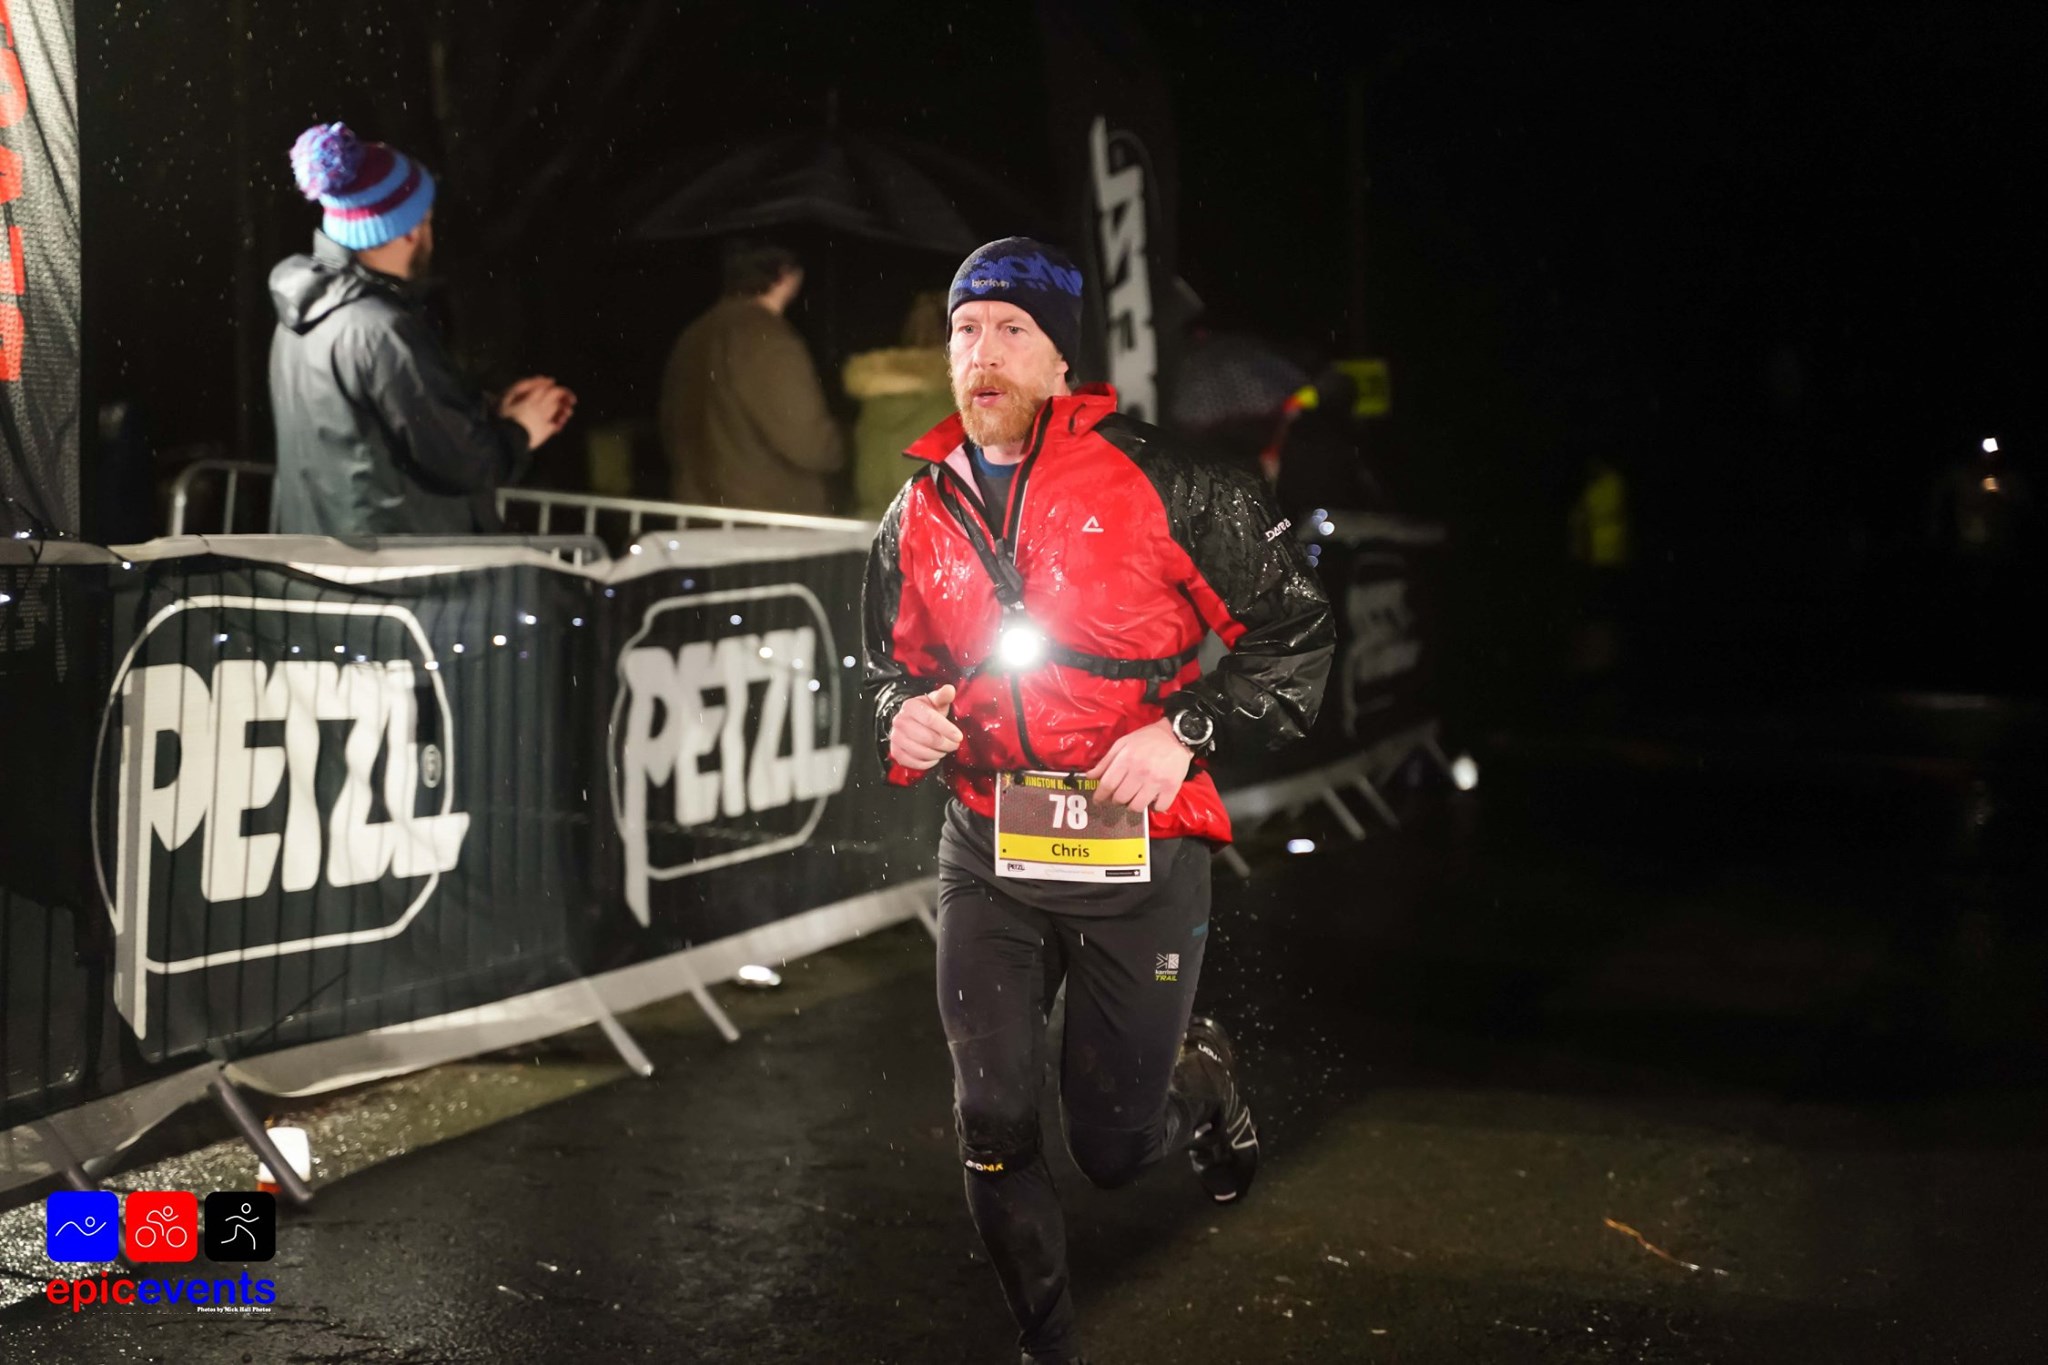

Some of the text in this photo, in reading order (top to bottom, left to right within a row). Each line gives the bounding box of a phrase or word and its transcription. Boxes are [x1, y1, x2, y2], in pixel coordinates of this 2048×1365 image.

[619, 627, 851, 928] PETZL
[1021, 776, 1057, 790] VINGTON
[1084, 779, 1100, 791] RU
[1049, 794, 1089, 830] 78
[114, 659, 470, 1041] PETZL
[1051, 843, 1090, 858] Chris
